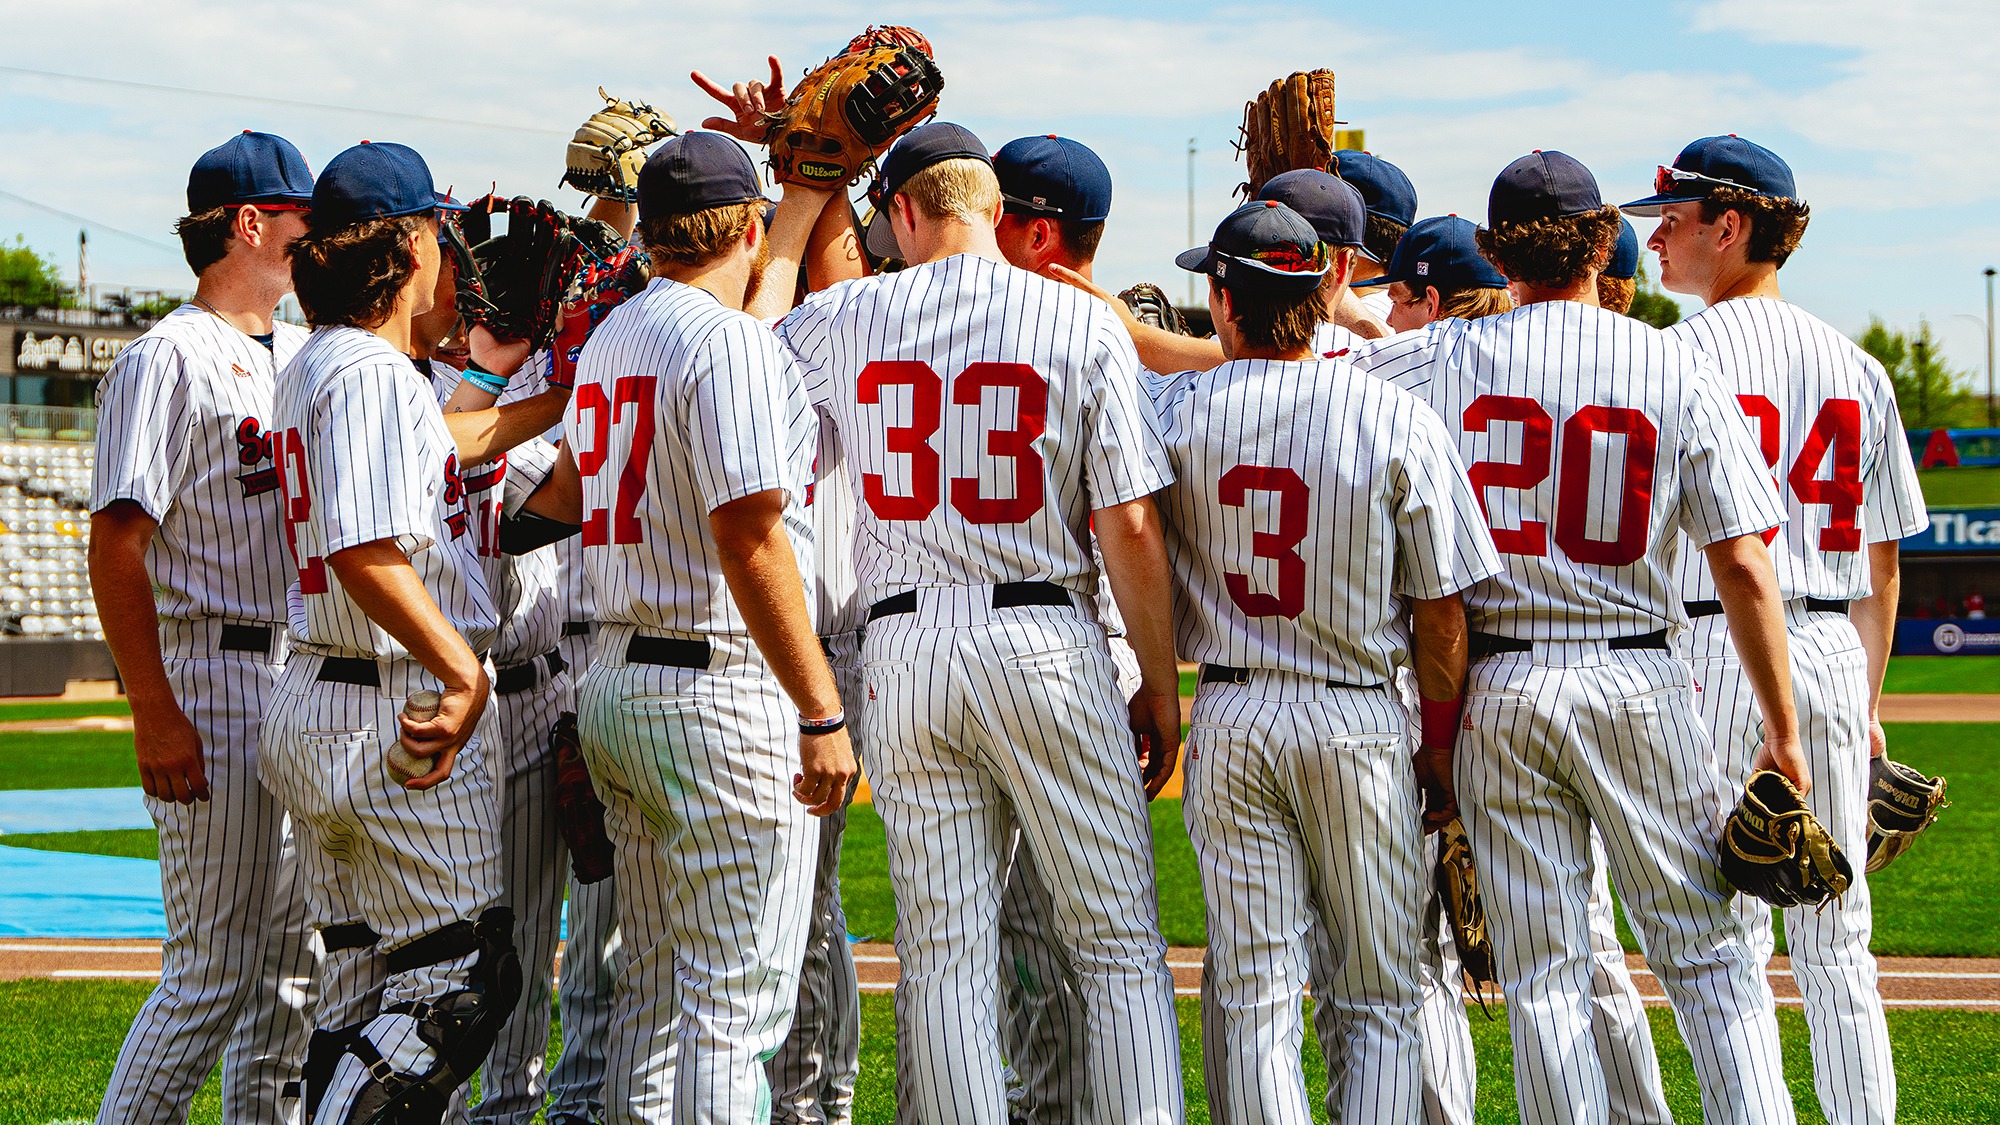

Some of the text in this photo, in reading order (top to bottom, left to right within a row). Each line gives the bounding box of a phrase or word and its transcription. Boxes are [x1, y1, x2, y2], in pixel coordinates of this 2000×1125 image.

[801, 164, 841, 177] Wilson
[576, 376, 658, 548] 27
[857, 360, 1047, 524] 33
[1463, 394, 1657, 567] 20
[1218, 463, 1310, 620] 3
[1878, 778, 1920, 809] Wilson
